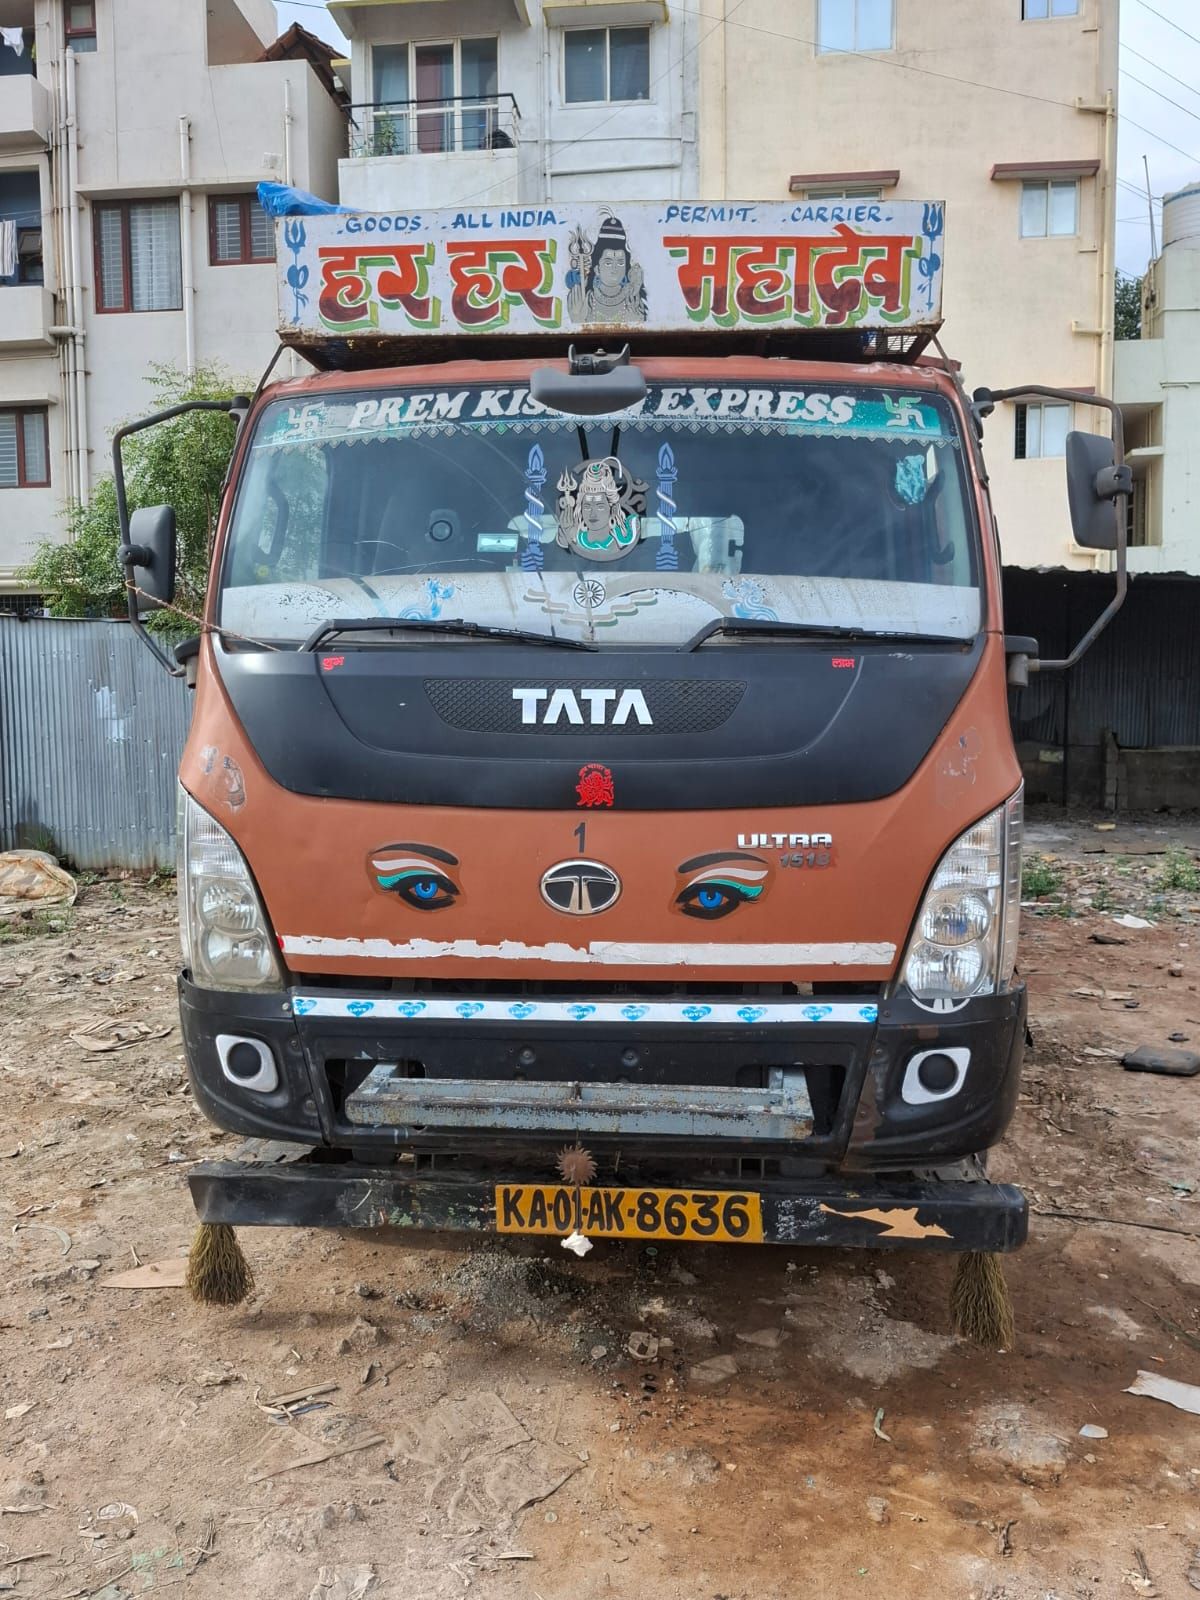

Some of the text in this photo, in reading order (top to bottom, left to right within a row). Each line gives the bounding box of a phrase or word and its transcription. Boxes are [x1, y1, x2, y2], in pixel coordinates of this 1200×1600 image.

[318, 223, 919, 330] हर हर महादेव
[347, 391, 470, 430] PREM
[653, 387, 856, 425] EXPRESS
[512, 688, 654, 725] TATA
[574, 822, 586, 853] 1
[737, 833, 833, 849] ULTRA
